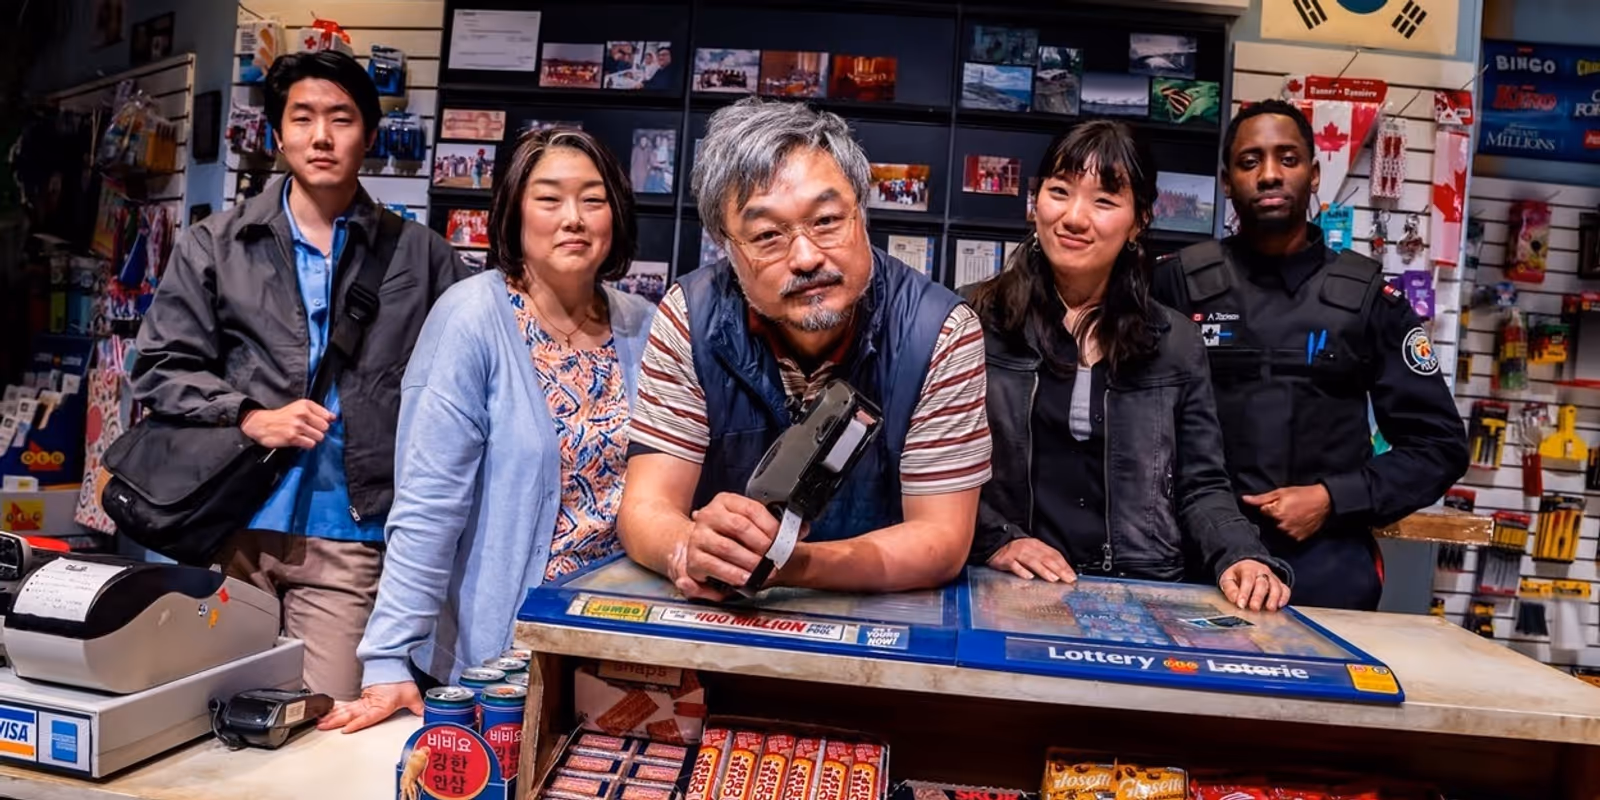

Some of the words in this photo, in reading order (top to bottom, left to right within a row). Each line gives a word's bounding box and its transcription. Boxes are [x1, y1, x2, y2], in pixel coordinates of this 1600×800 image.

[1496, 55, 1556, 74] BINGO
[1486, 131, 1555, 150] MILLIONS
[592, 604, 640, 615] JUMBO
[730, 615, 807, 633] MILLION
[1048, 646, 1155, 670] Lottery
[1207, 659, 1310, 680] Loterie
[427, 733, 471, 752] 비비요
[433, 752, 468, 774] 강한
[432, 774, 466, 794] 인삼
[696, 760, 711, 793] CRISP
[724, 756, 742, 797] COFFEE
[733, 763, 748, 798] CRISP
[793, 771, 806, 800] RISP
